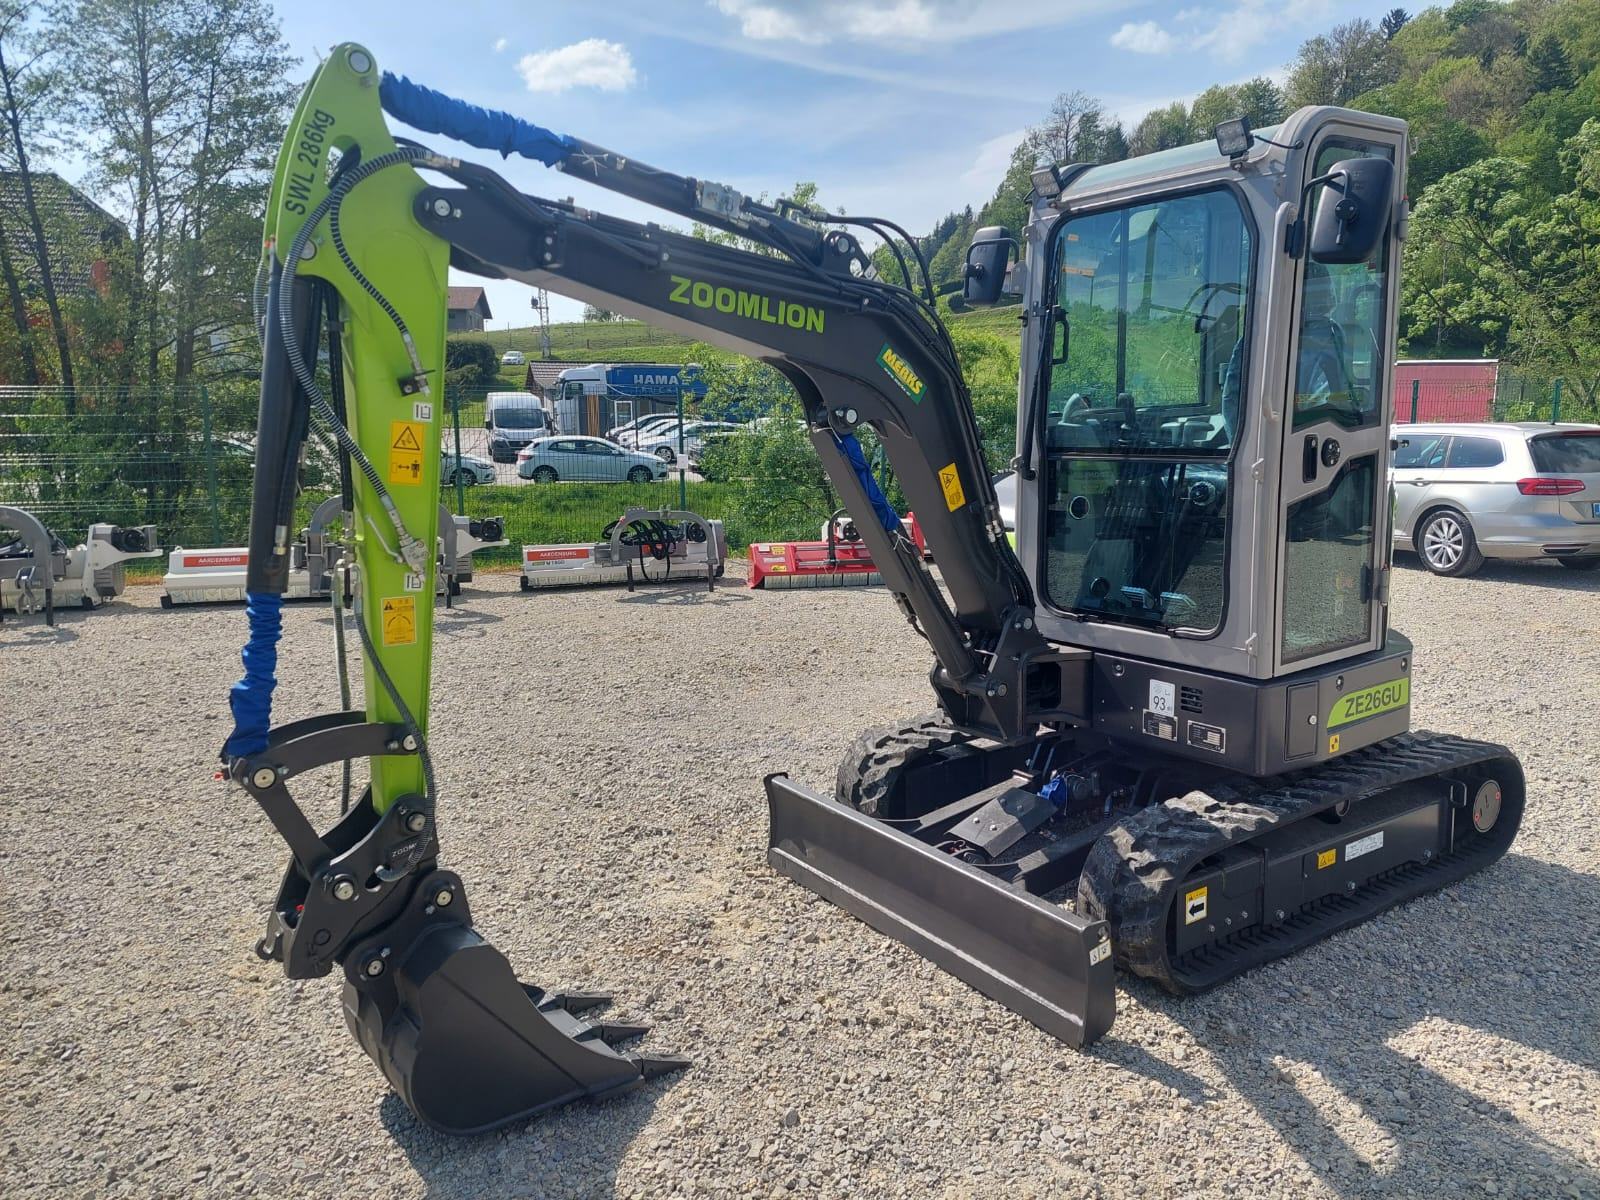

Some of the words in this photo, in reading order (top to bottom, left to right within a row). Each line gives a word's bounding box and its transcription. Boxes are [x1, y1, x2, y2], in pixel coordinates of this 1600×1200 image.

[297, 108, 336, 169] 286kg
[285, 173, 315, 215] SWL
[669, 275, 825, 333] ZOOMLION
[1153, 695, 1166, 711] 93
[1344, 684, 1401, 718] ZE26GU
